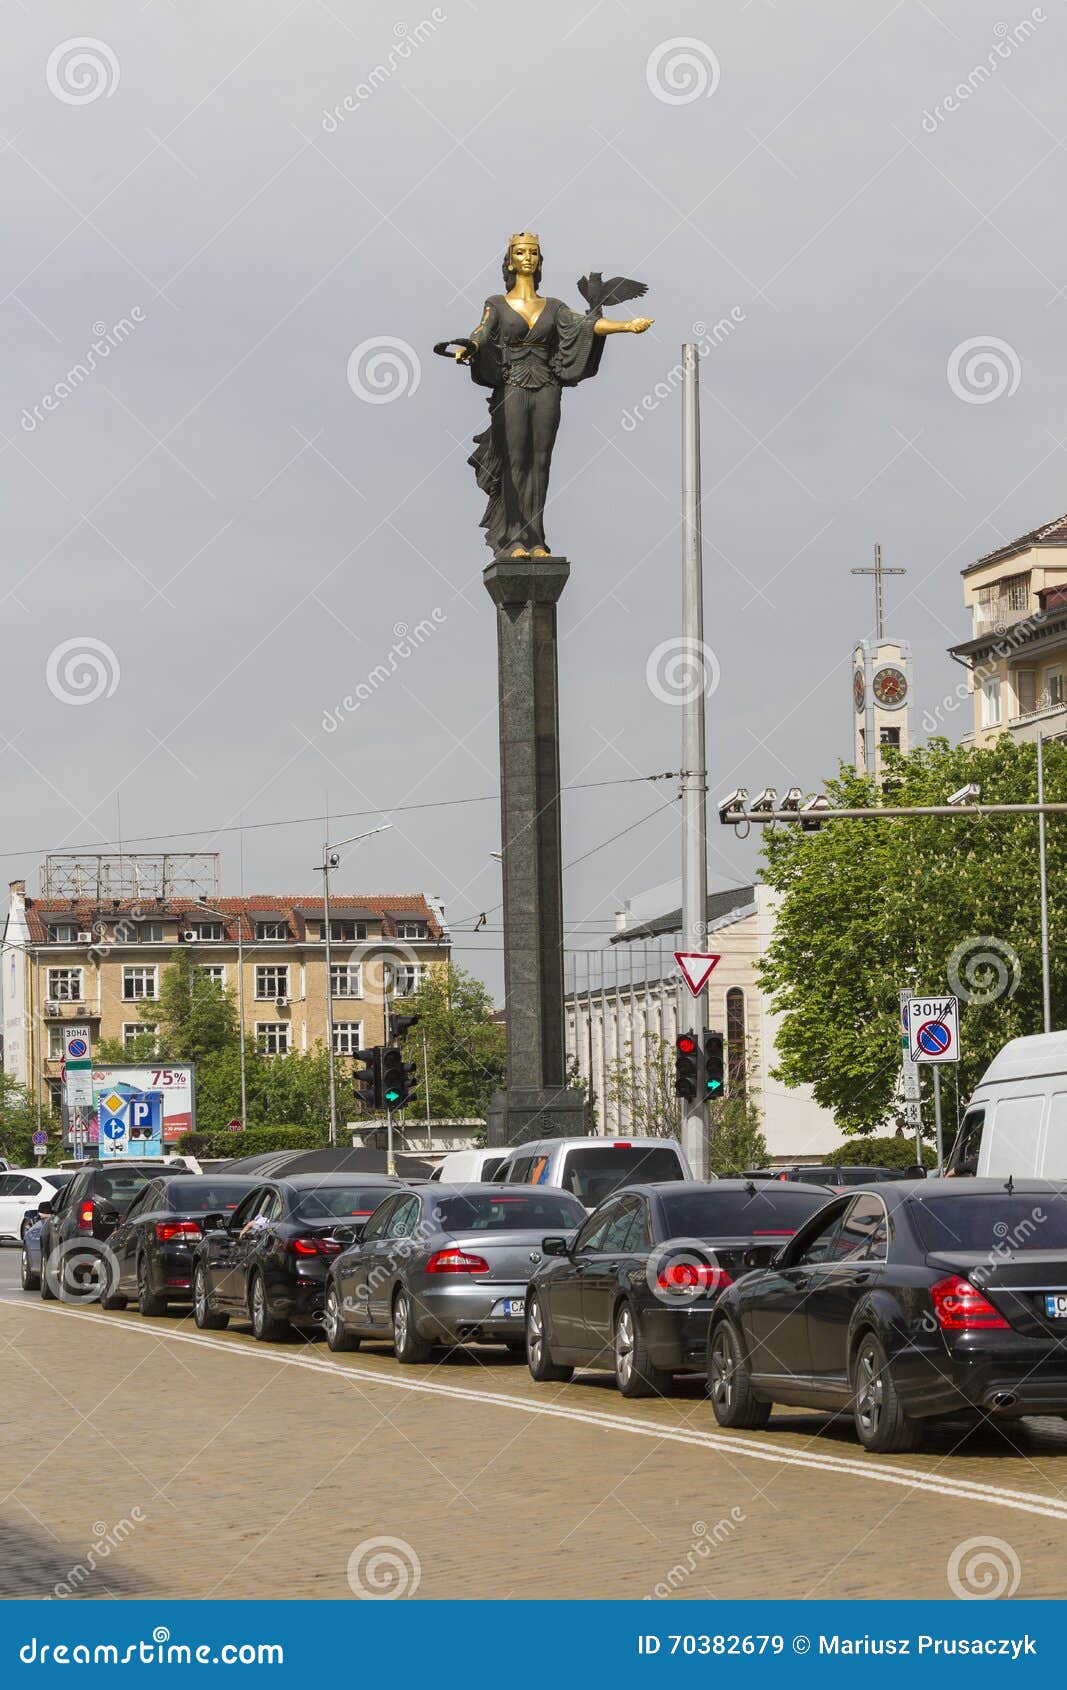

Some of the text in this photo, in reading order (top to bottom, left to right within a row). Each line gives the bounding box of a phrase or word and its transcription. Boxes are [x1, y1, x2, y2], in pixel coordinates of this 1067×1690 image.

[913, 1003, 953, 1016] ЗОНА
[66, 1029, 88, 1037] ЗОНА
[151, 1070, 186, 1086] 75%
[134, 1103, 149, 1126] P
